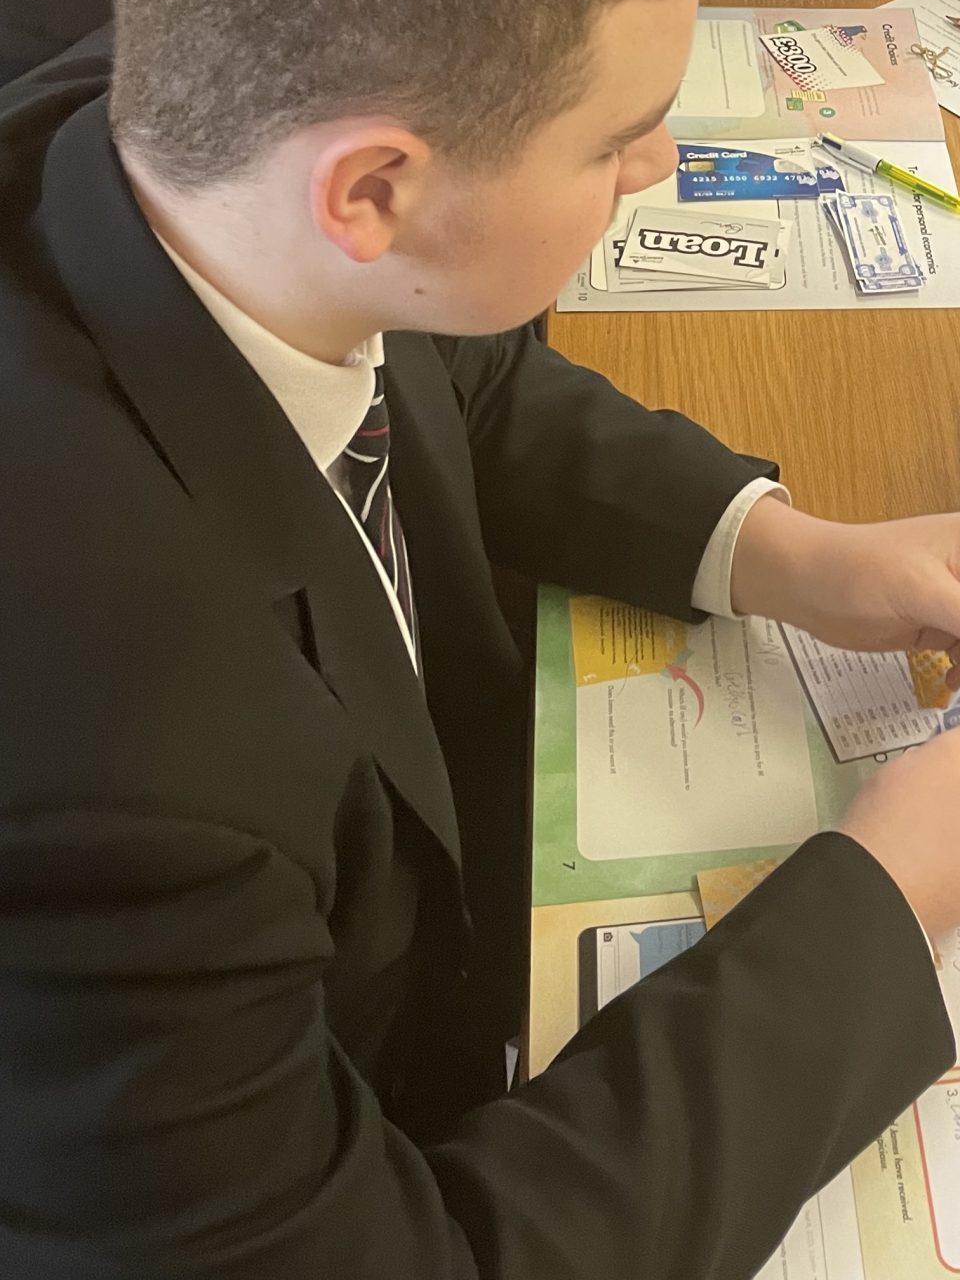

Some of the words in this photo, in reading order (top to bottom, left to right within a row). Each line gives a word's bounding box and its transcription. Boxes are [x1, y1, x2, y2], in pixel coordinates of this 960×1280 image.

[770, 36, 818, 75] £300
[912, 193, 923, 205] for
[912, 204, 932, 237] personal
[638, 228, 769, 269] Loan
[922, 237, 938, 274] economics
[895, 1157, 904, 1180] have
[898, 1181, 913, 1224] received.
